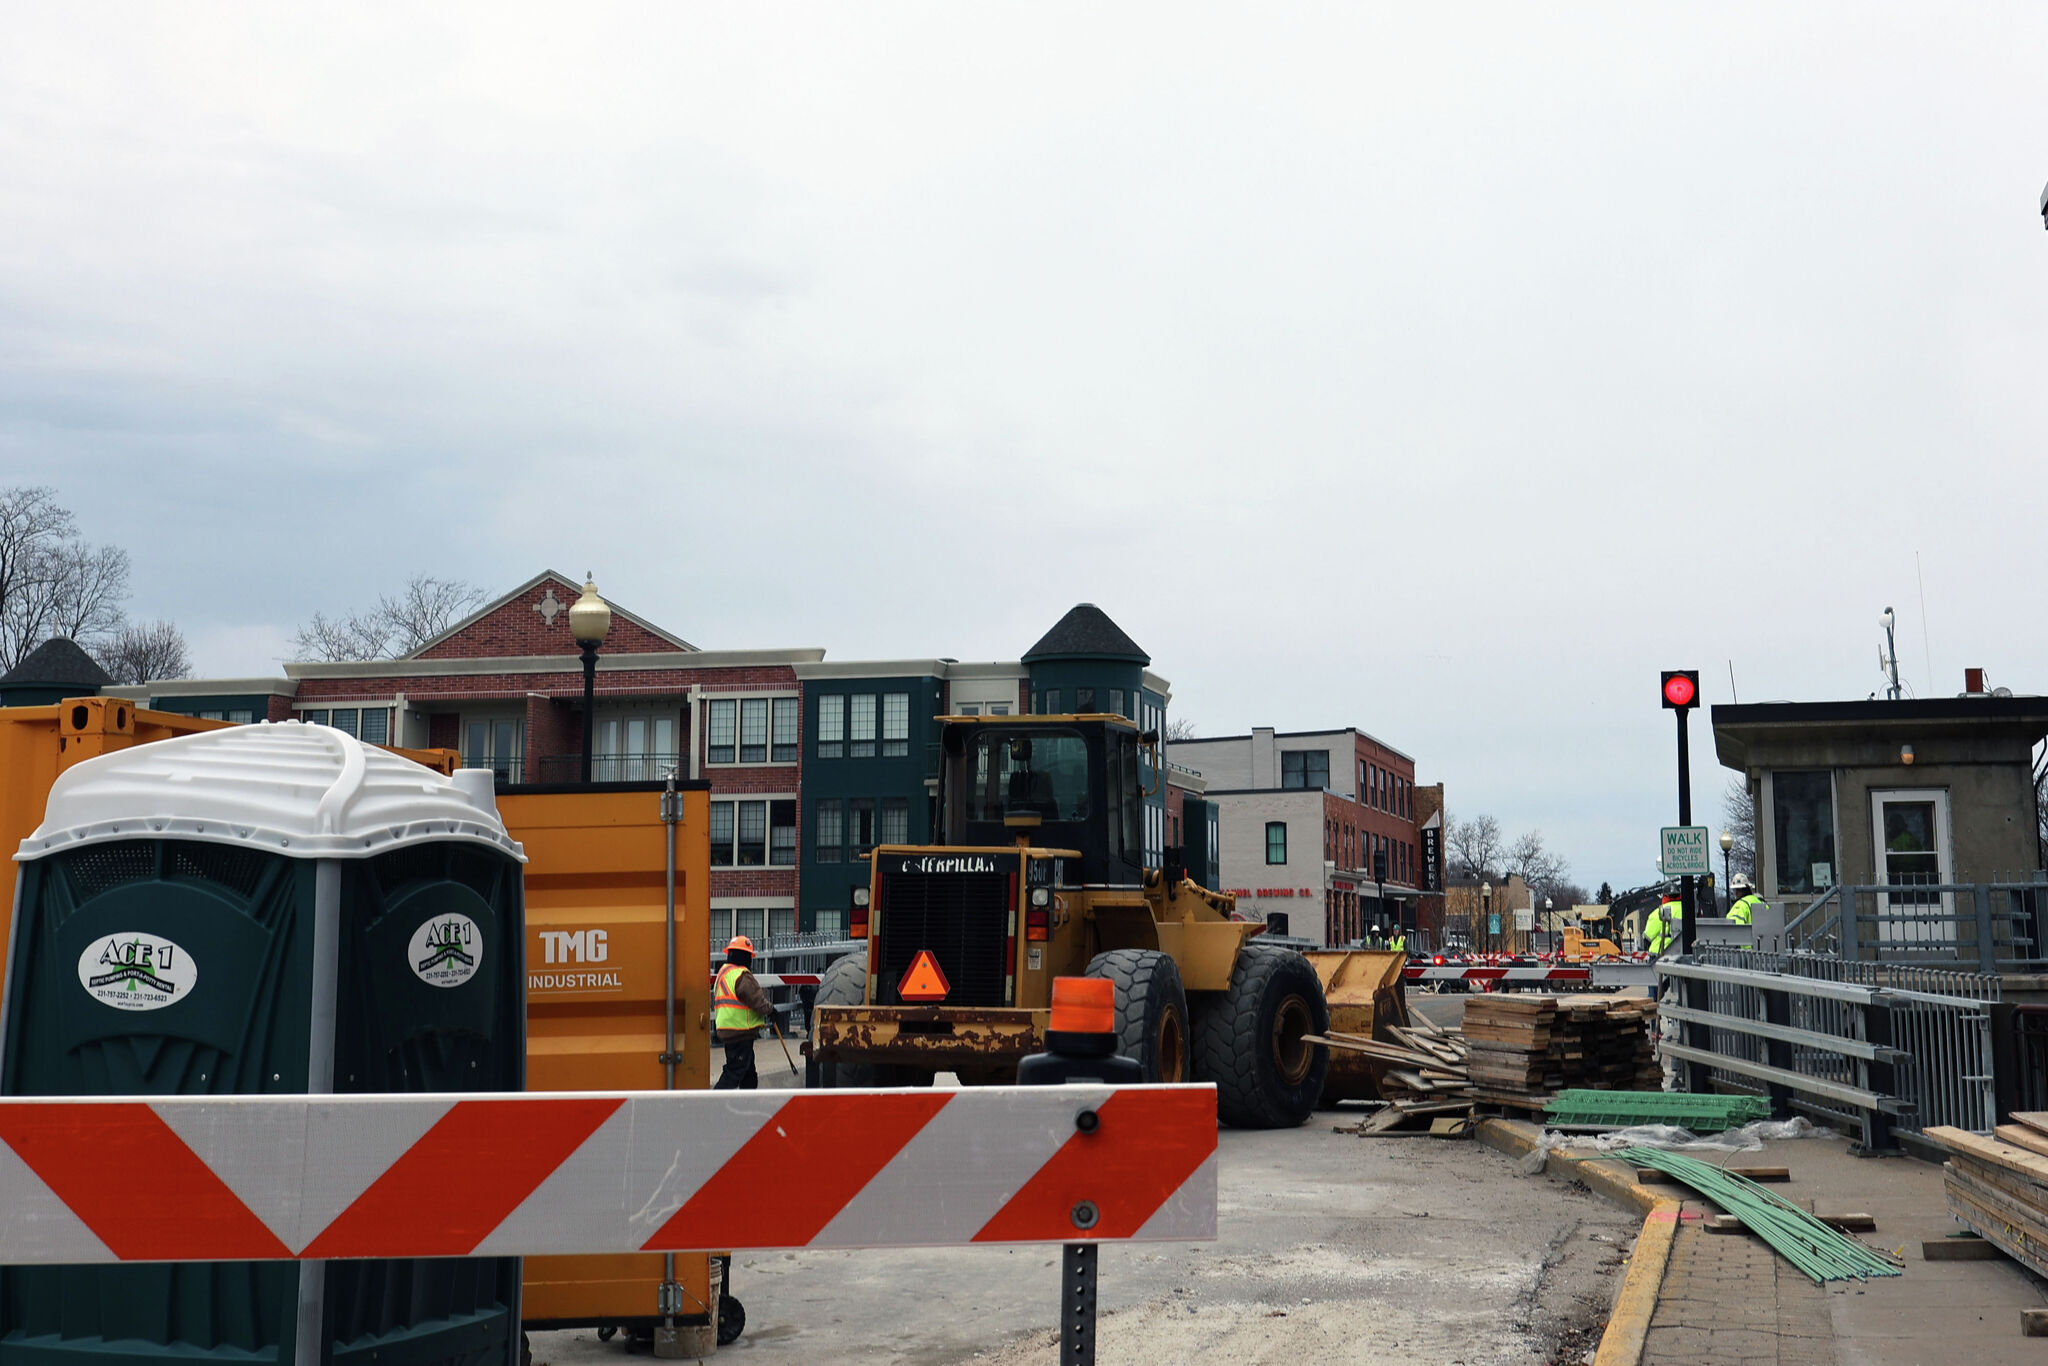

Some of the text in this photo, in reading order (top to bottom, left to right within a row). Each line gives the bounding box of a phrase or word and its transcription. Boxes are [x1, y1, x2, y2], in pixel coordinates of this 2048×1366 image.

[1667, 832, 1702, 845] WALK
[1426, 829, 1435, 889] BREWERY
[1256, 888, 1294, 898] BREWING
[426, 921, 471, 948] ACE 1
[100, 938, 173, 970] ACE 1
[539, 929, 608, 963] TMG
[156, 981, 173, 991] RENTAL
[528, 973, 622, 989] INDUSTRIAL
